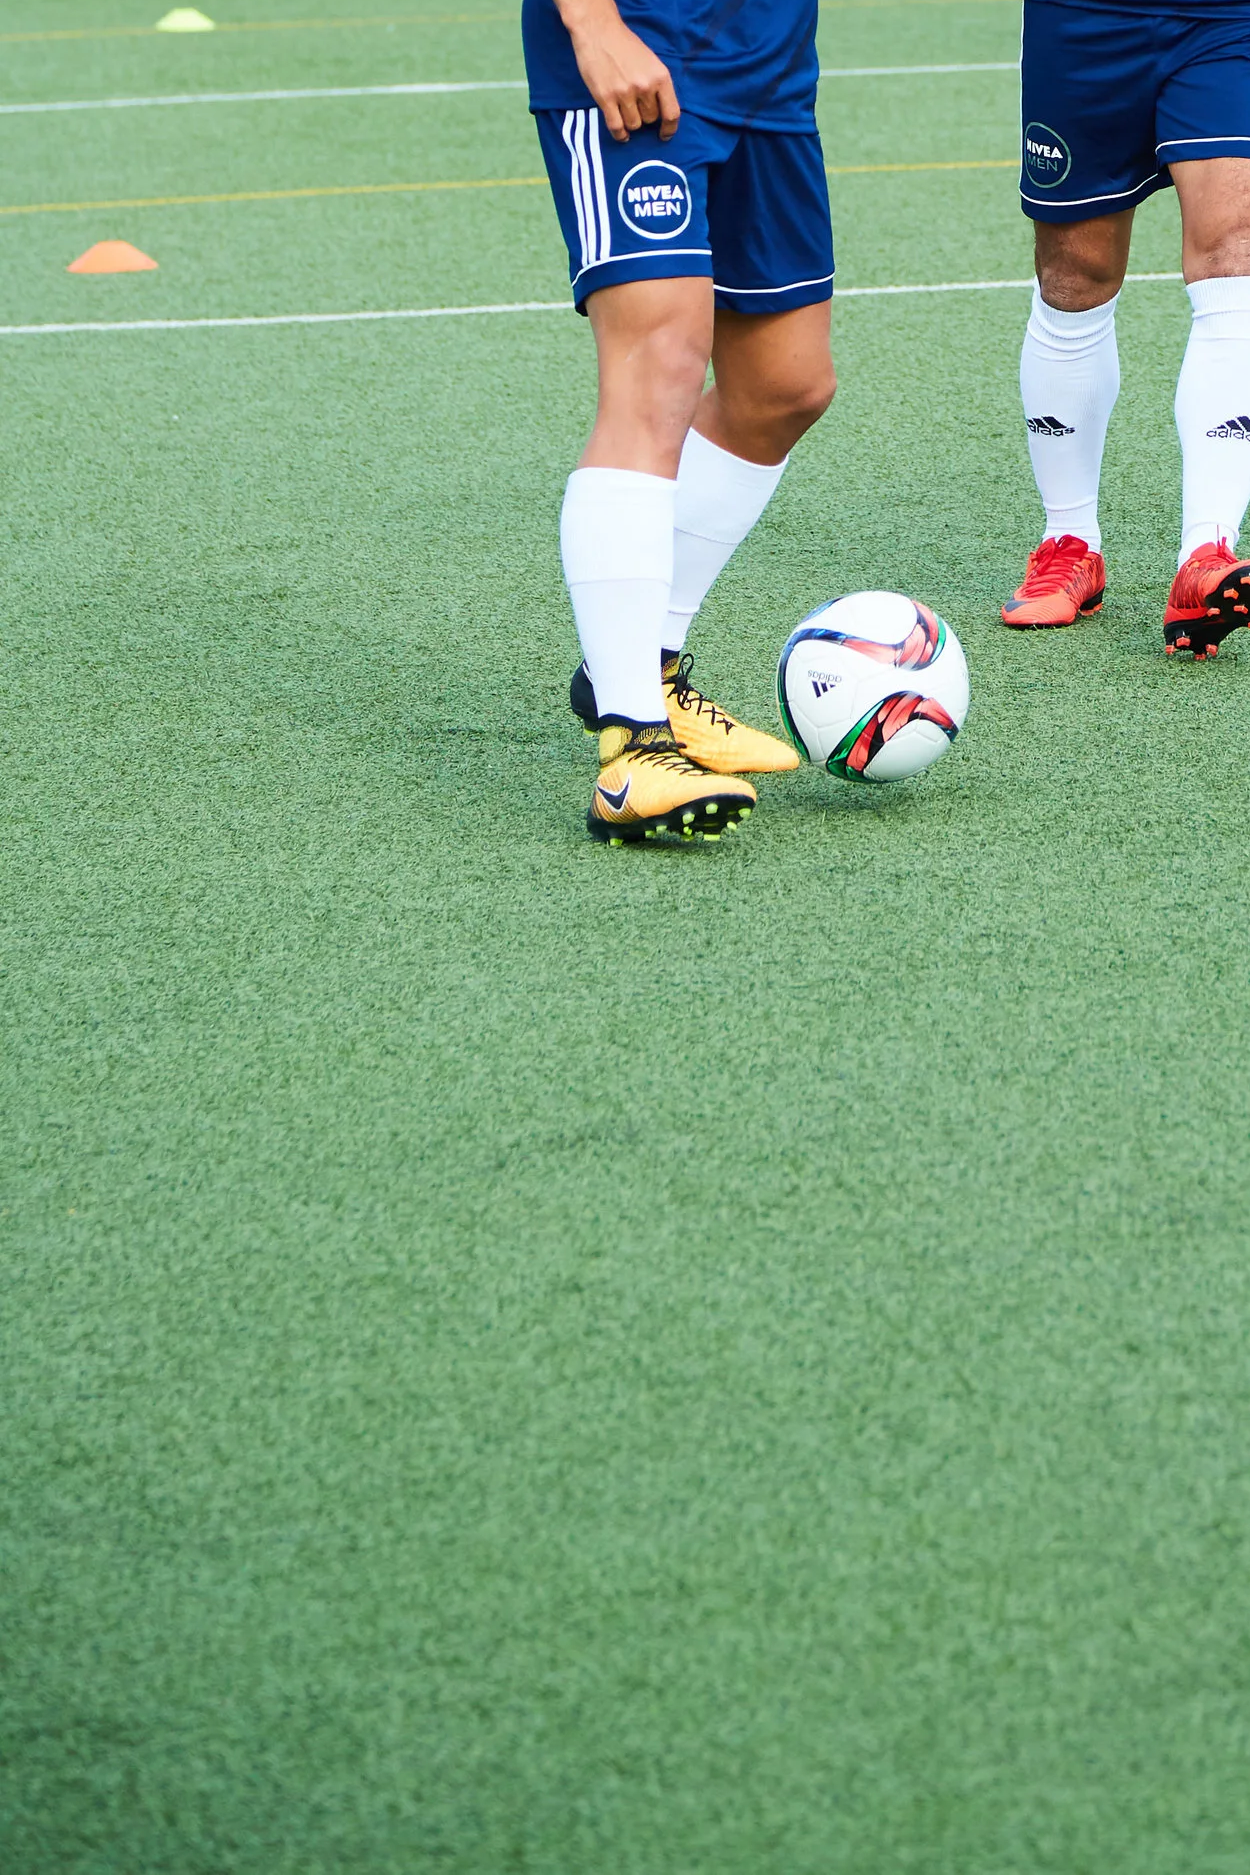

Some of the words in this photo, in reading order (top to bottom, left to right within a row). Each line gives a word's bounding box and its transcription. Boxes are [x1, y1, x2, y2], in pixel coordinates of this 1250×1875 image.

[1026, 138, 1064, 159] NIVEA
[1027, 154, 1059, 172] MEN
[627, 184, 685, 203] NIVEA
[634, 201, 682, 218] MEN
[807, 669, 842, 683] adidas
